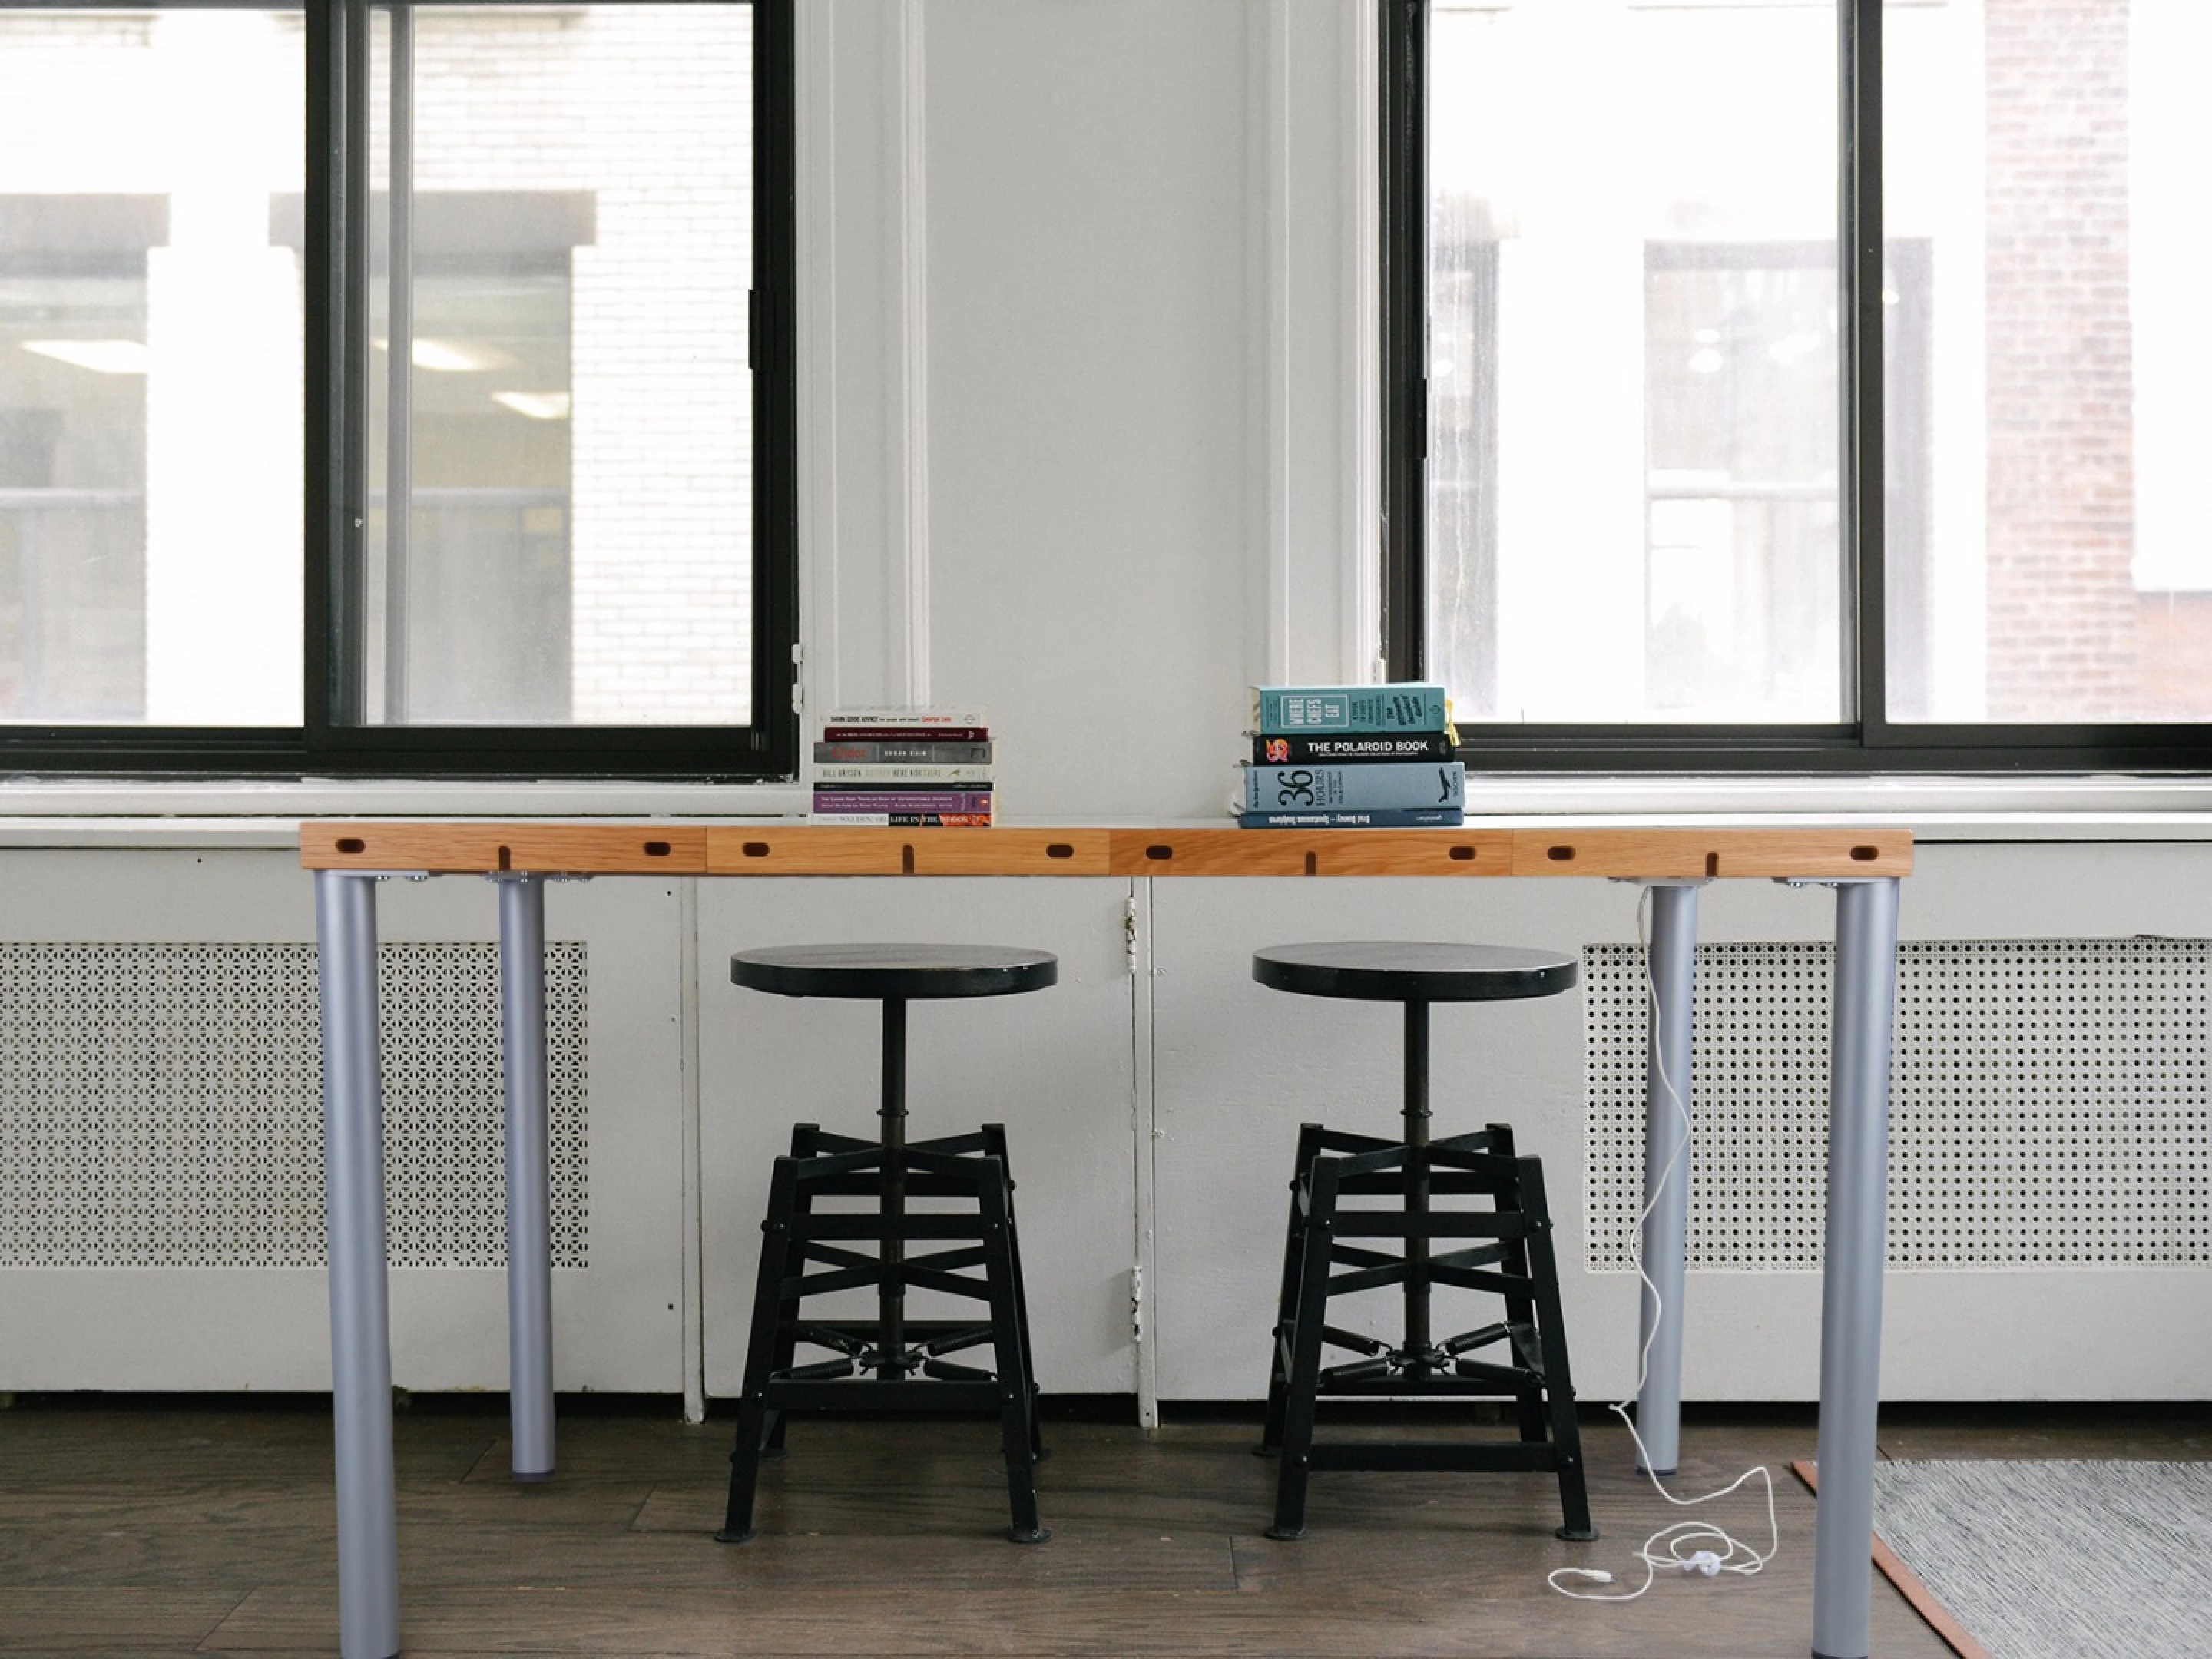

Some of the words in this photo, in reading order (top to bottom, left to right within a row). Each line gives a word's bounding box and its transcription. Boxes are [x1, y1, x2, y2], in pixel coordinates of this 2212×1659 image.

[1307, 742, 1331, 753] THE
[1334, 742, 1392, 752] POLAROID
[1396, 741, 1429, 751] BOOK
[1277, 769, 1314, 806] 36
[1315, 769, 1326, 806] HOURS
